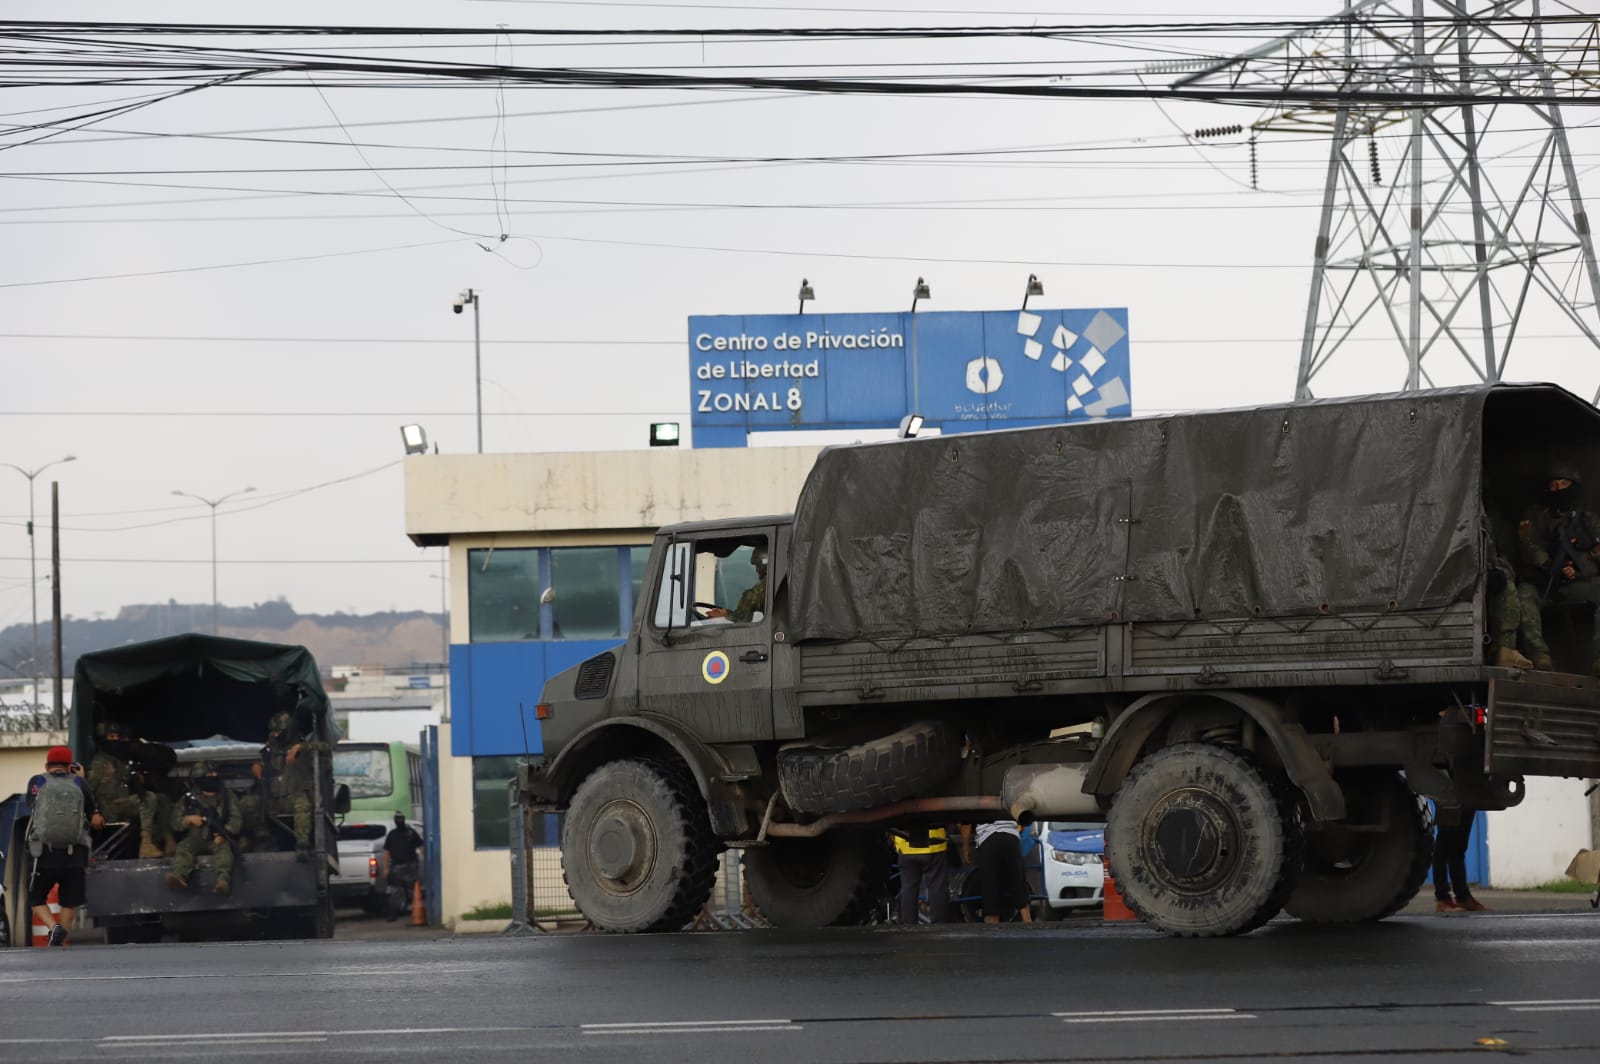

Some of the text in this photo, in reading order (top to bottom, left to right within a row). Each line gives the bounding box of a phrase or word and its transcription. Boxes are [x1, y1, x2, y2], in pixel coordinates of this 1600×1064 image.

[696, 327, 904, 351] Centro de Privación
[697, 360, 819, 379] de Libertad
[698, 387, 802, 412] ZONAL 8
